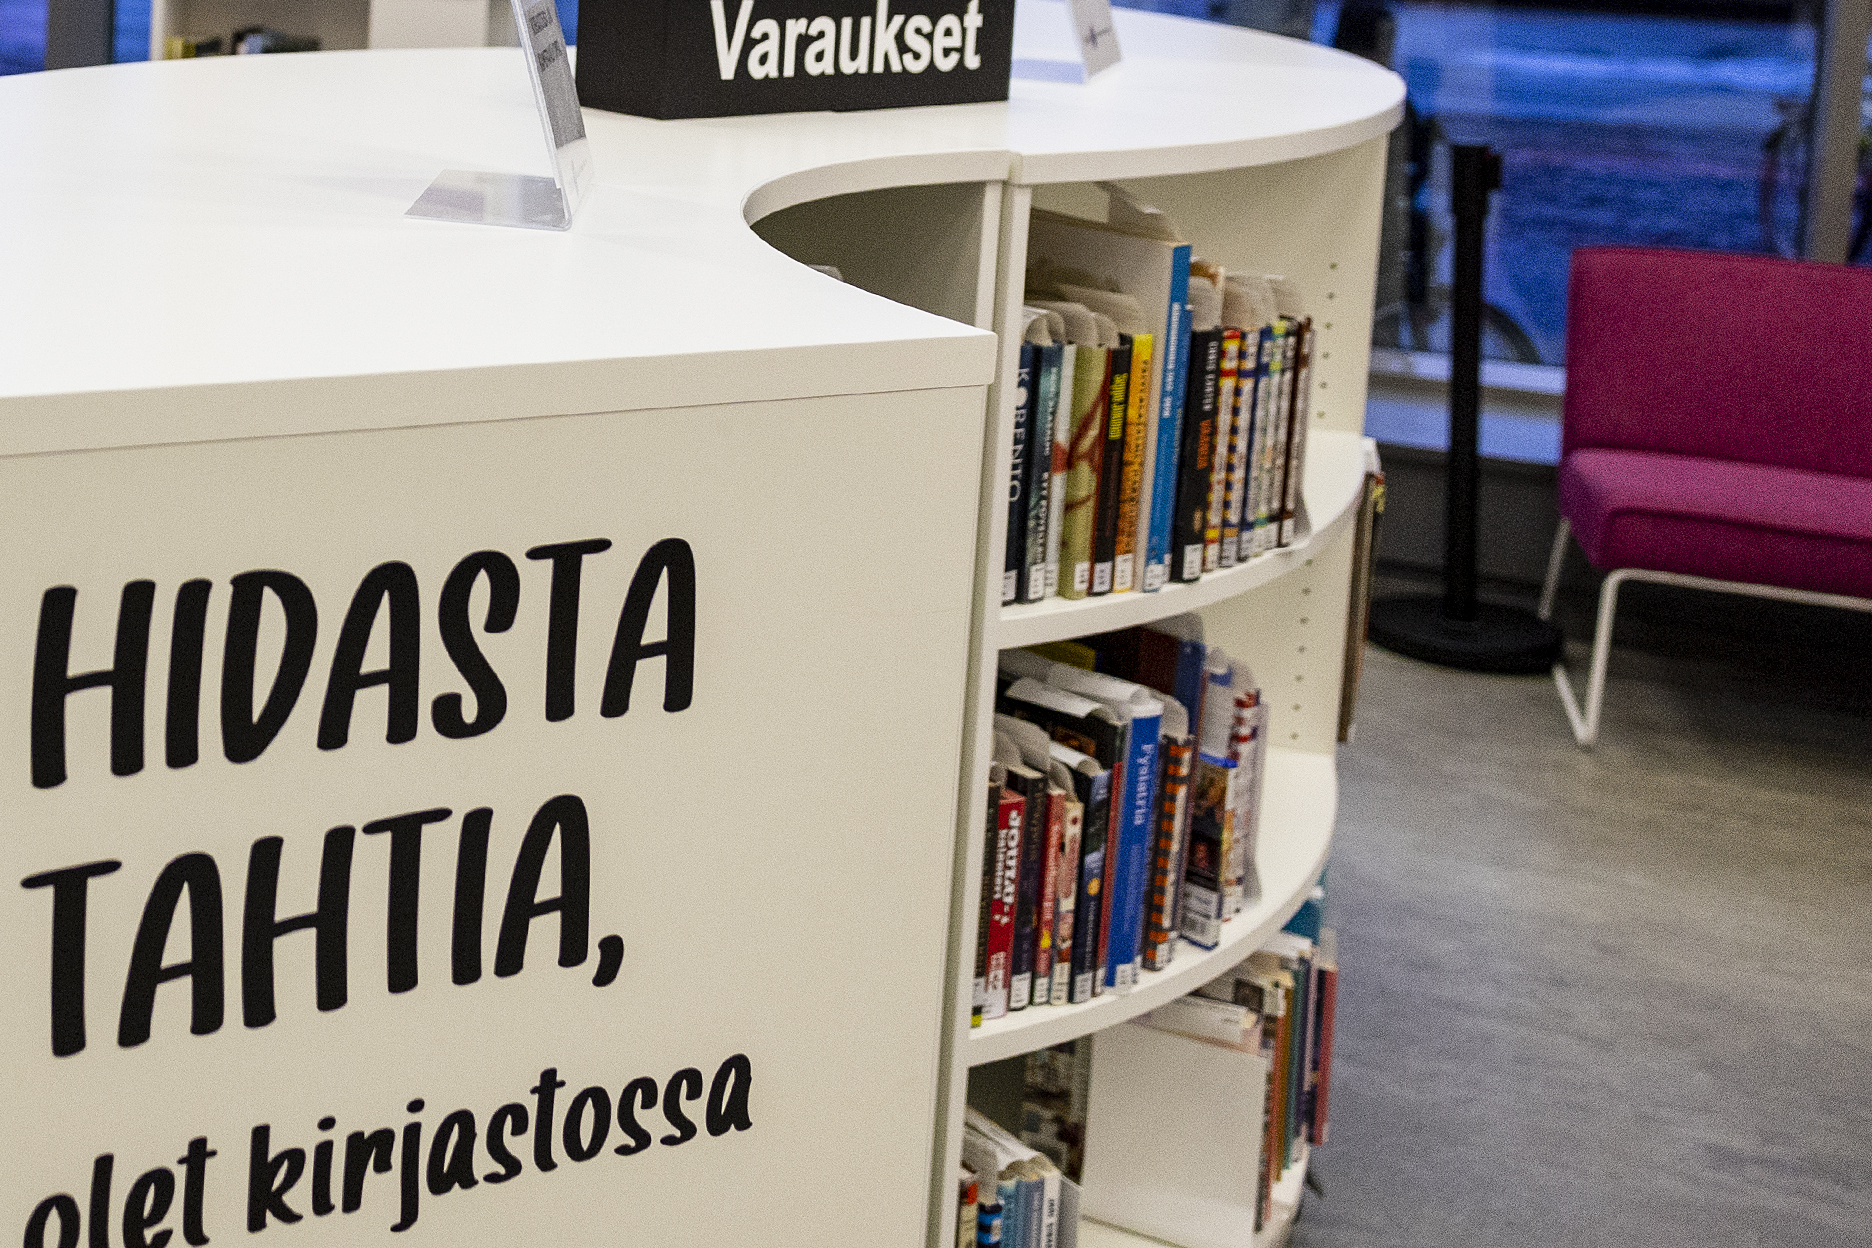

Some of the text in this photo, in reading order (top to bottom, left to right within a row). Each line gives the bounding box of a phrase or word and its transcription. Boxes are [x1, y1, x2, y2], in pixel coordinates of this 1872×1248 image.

[31, 537, 696, 790] HIDASTA
[1133, 743, 1156, 826] Fysiatria
[20, 793, 625, 1059] TAHTIA,
[23, 1053, 754, 1248] olet kirjastossa
